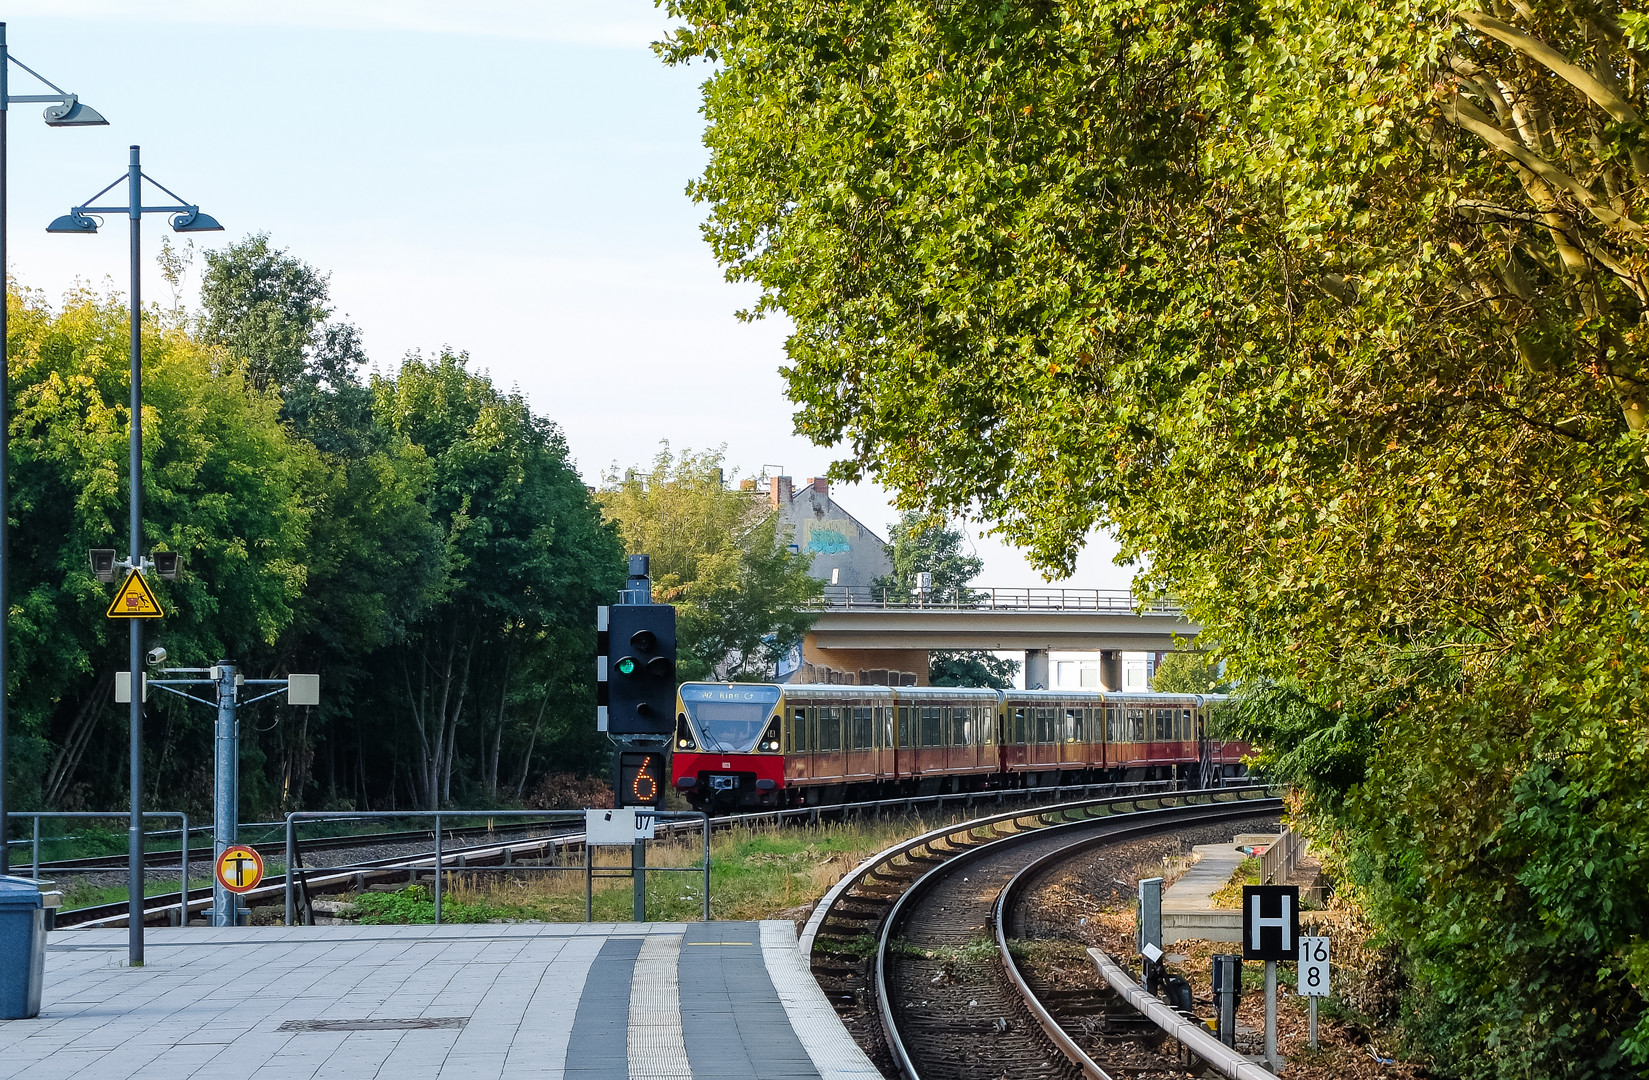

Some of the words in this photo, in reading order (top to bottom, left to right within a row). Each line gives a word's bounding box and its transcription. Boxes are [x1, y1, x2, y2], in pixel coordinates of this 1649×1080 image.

[633, 756, 658, 801] 6
[1251, 894, 1292, 951] H
[1302, 941, 1328, 962] 16
[1307, 966, 1321, 987] 8
